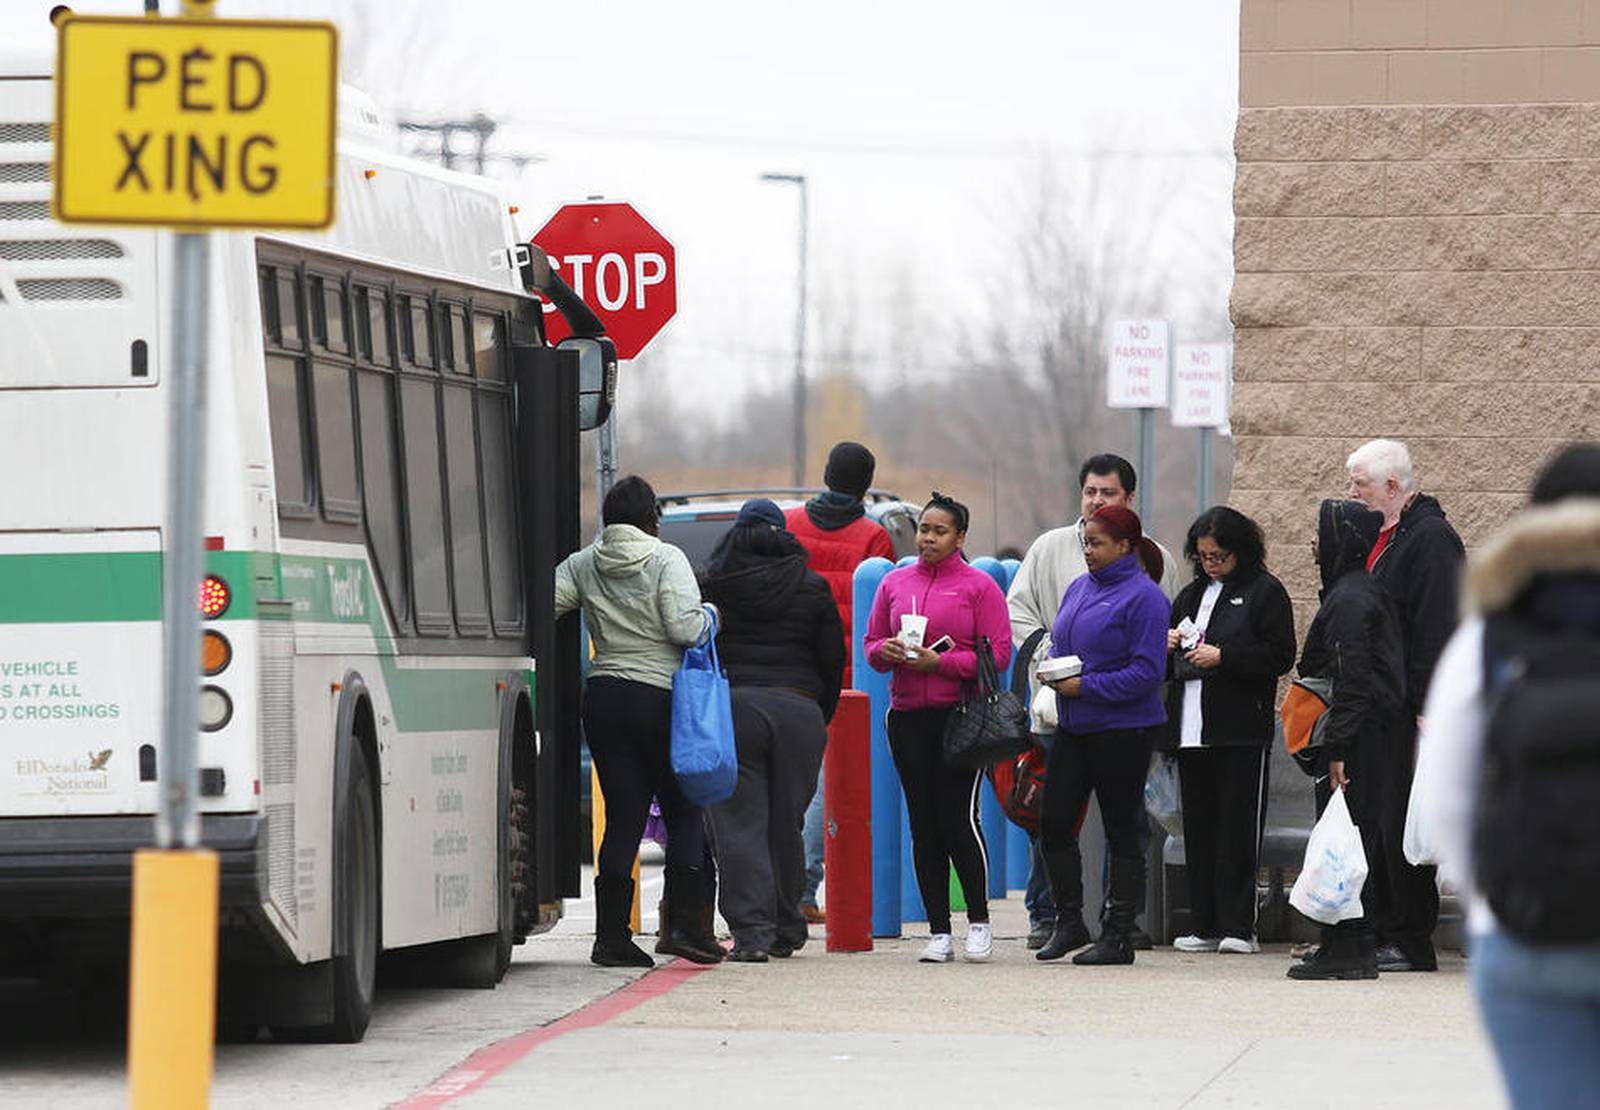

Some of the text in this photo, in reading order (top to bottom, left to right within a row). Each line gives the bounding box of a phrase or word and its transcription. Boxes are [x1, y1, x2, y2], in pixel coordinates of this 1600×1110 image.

[126, 46, 268, 113] PED
[115, 131, 279, 201] XING
[1128, 325, 1150, 340] NO
[1115, 347, 1164, 360] PARKING
[1191, 351, 1211, 366] NO
[1178, 370, 1222, 383] PARKING
[1, 661, 79, 677] VEHICLE
[19, 684, 41, 698] AT
[48, 683, 81, 698] ALL
[12, 703, 121, 720] CROSSINGS
